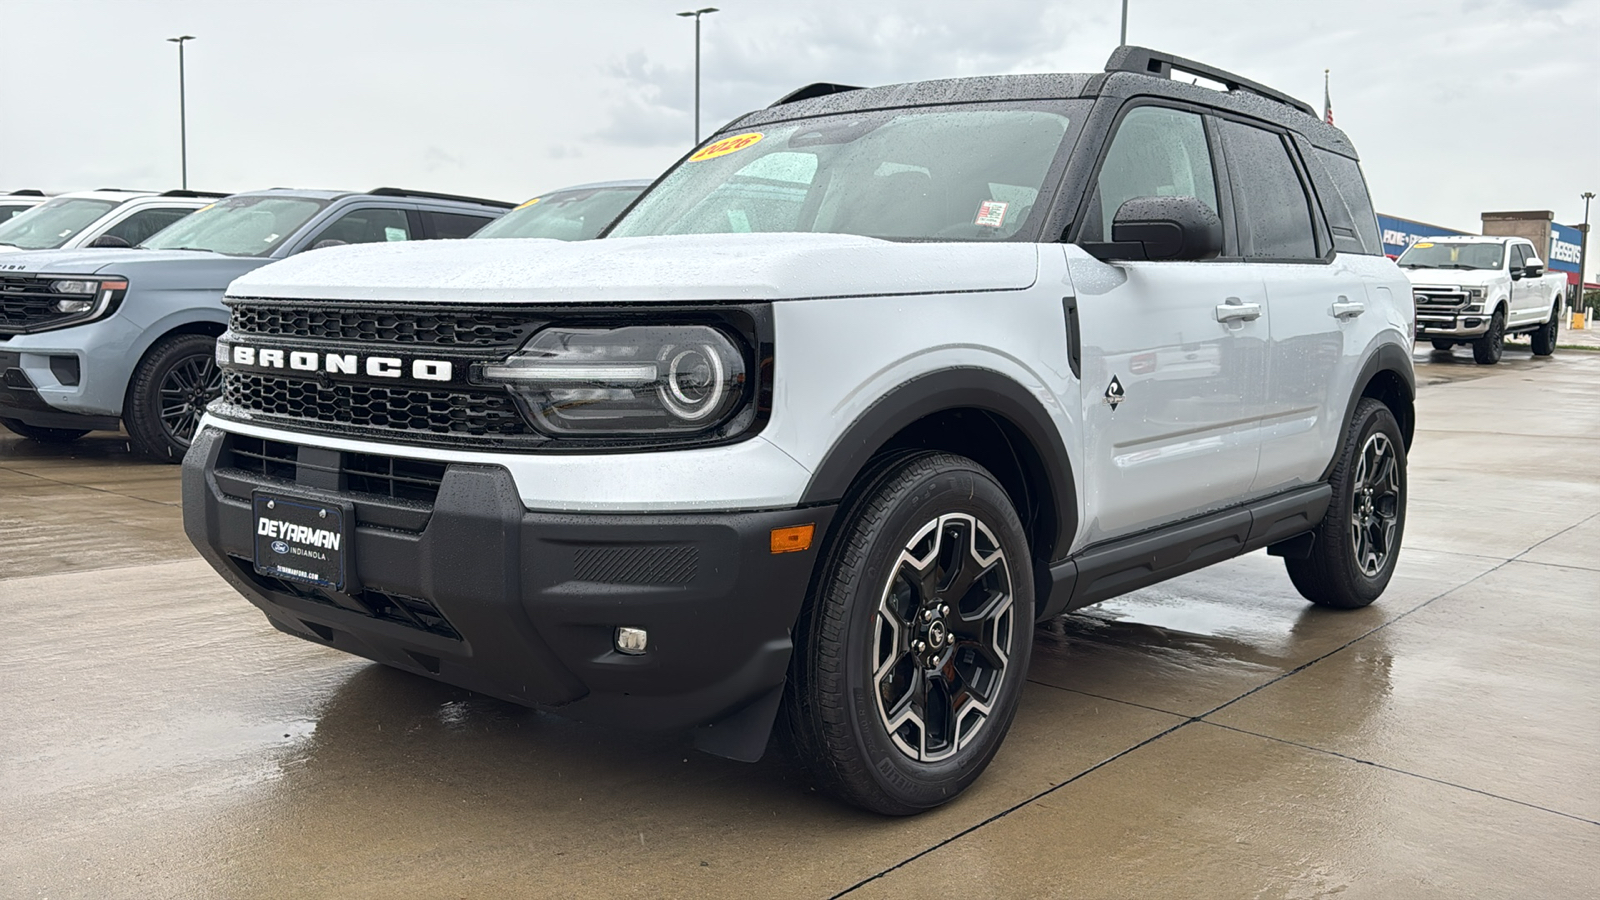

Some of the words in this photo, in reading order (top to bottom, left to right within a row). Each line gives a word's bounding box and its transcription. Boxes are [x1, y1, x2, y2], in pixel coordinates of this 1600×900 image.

[693, 135, 757, 160] 2026
[234, 346, 452, 381] BRONCO
[258, 517, 341, 551] DEYARMAN
[290, 546, 326, 561] INDIANOLA
[277, 565, 319, 580] DEYARMANFORD.COM
